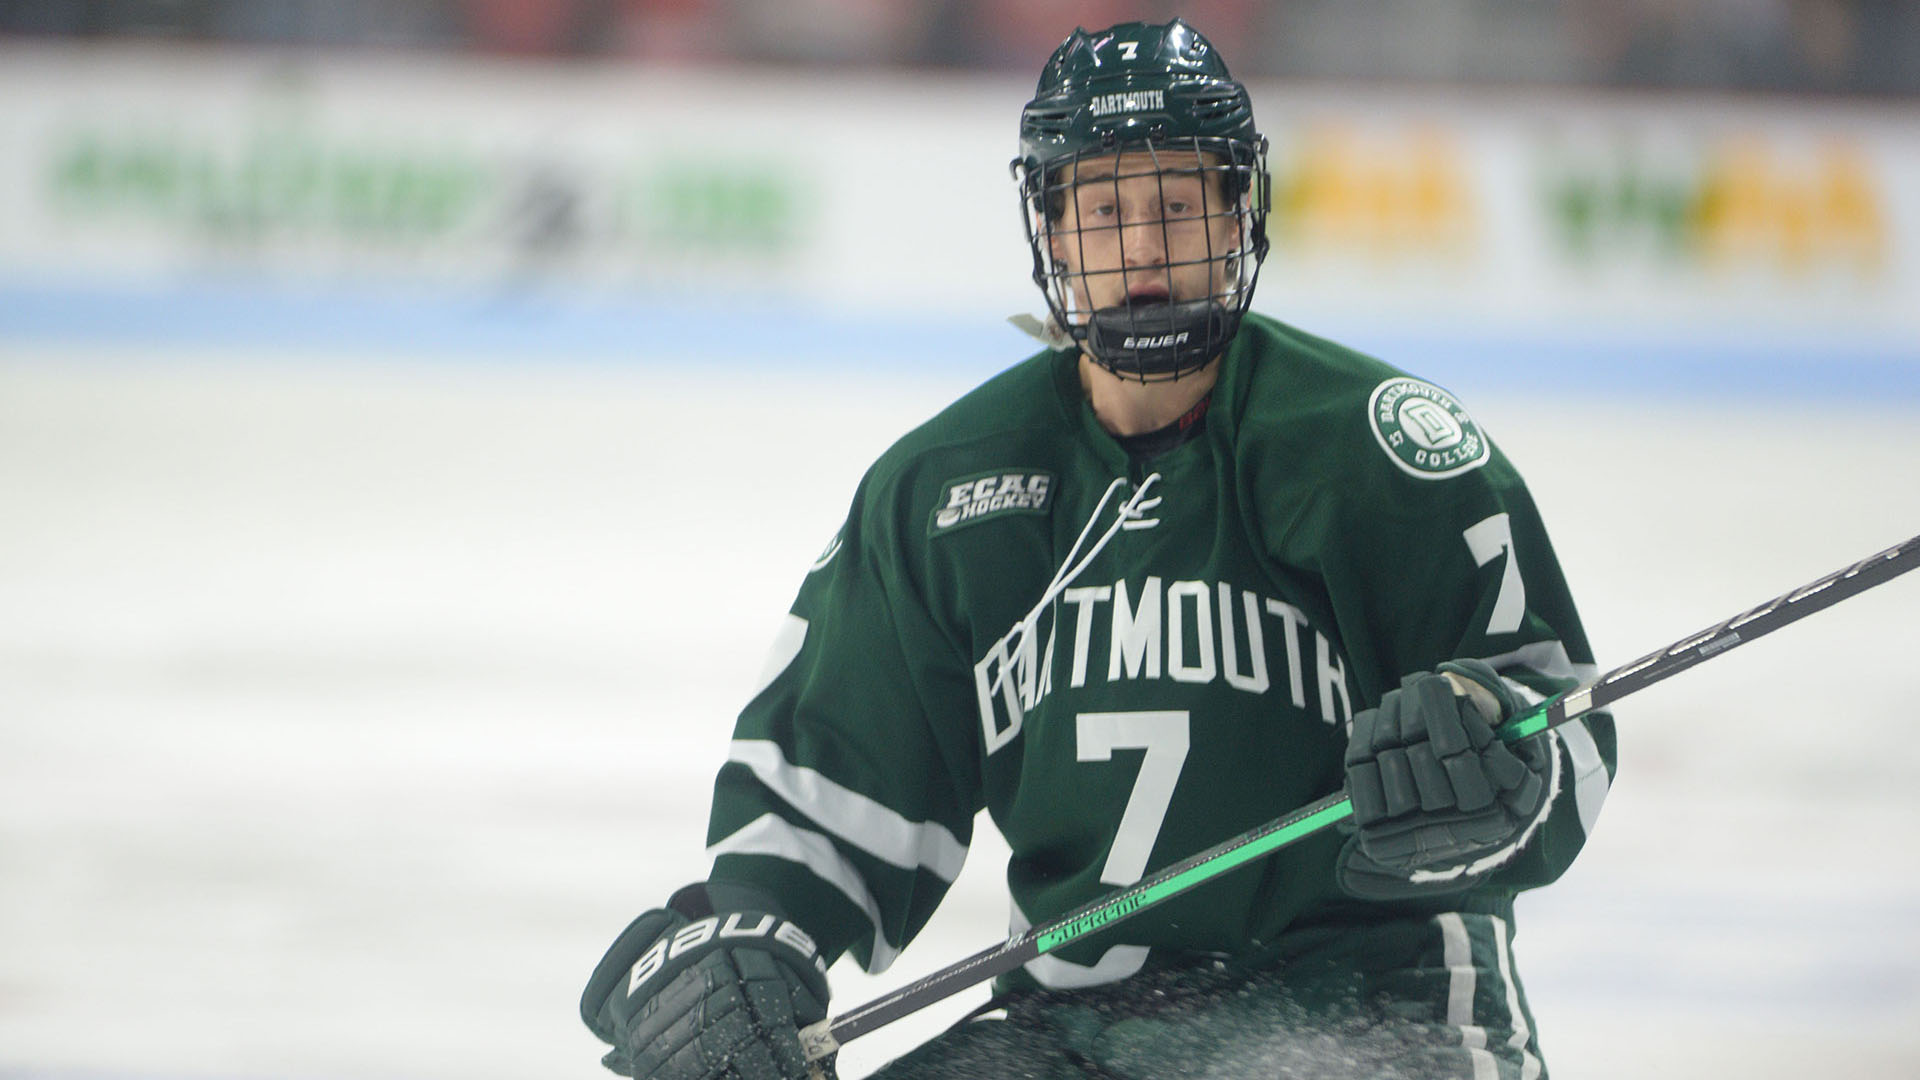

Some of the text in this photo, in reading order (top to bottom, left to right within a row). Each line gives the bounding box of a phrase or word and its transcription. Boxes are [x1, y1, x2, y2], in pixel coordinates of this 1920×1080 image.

[1118, 41, 1139, 60] 7
[1092, 90, 1165, 117] DARTMOUTH
[1123, 332, 1189, 349] BAUER
[946, 474, 1050, 510] ECAC
[960, 493, 1046, 521] HOCKEY
[1463, 512, 1525, 636] 7
[1076, 710, 1191, 888] 7
